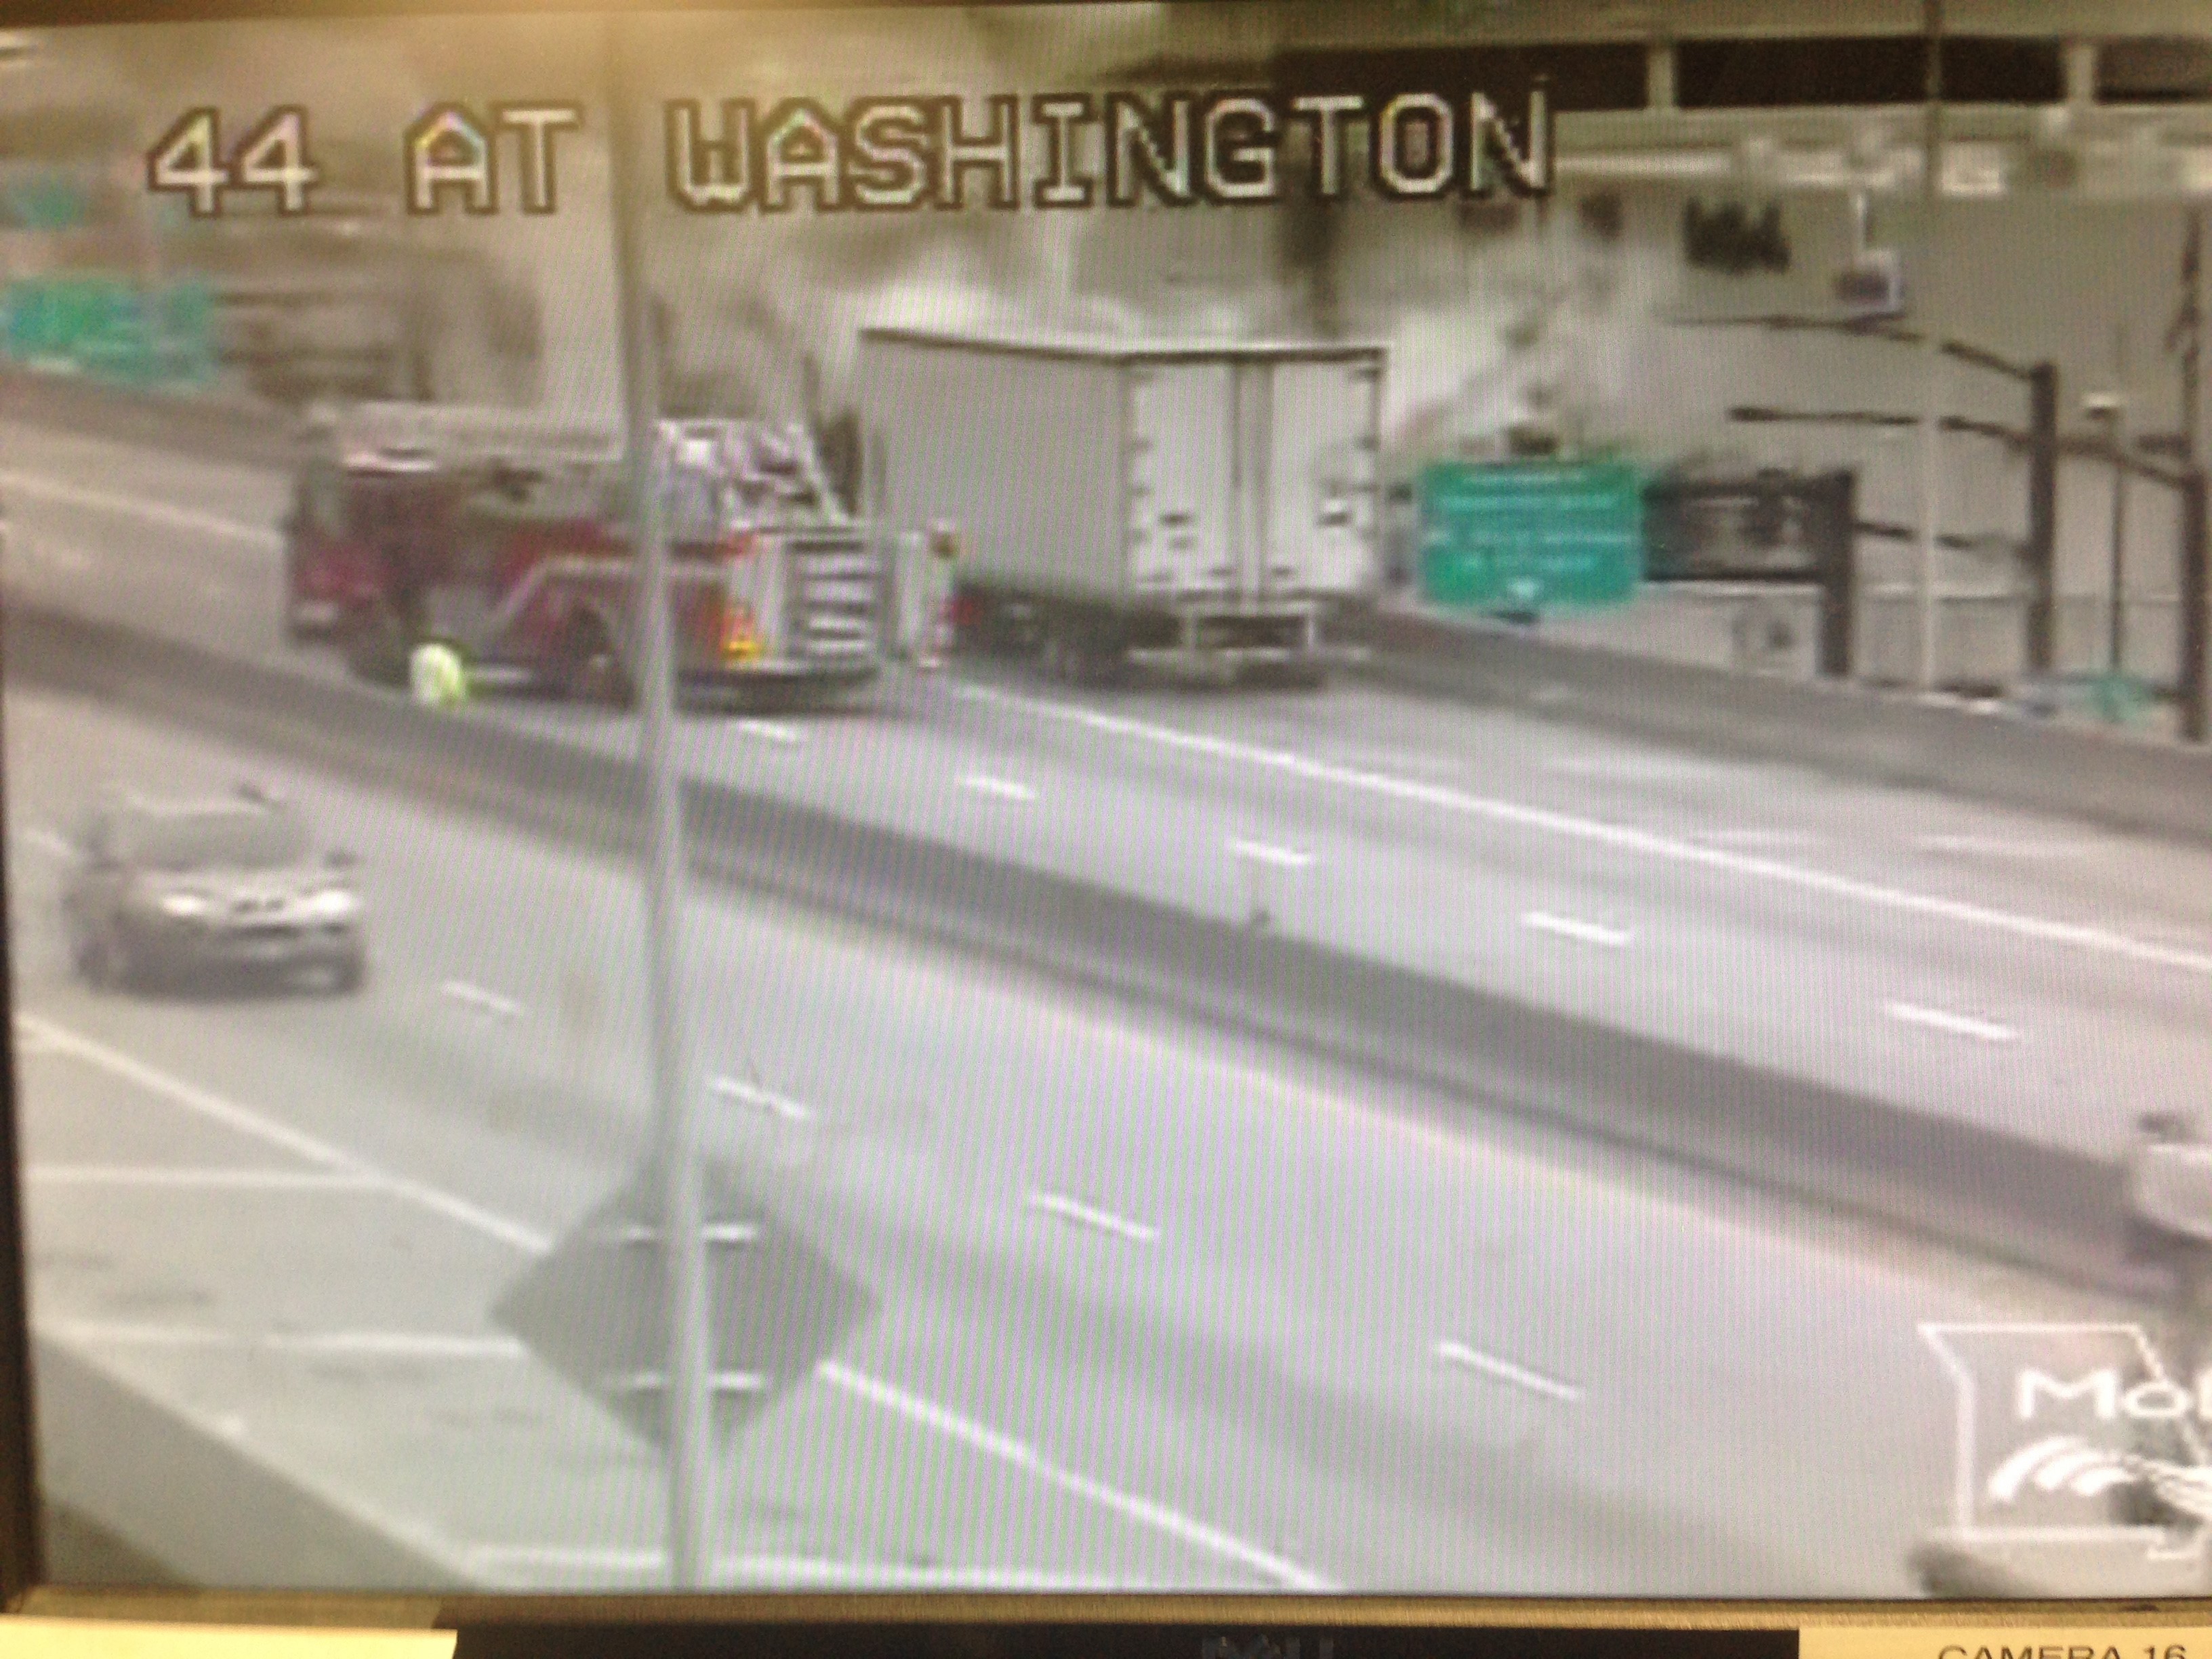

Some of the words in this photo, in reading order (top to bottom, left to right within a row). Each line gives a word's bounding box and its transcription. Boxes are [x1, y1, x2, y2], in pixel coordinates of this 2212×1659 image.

[148, 104, 319, 216] 44
[405, 100, 583, 214] AT
[668, 88, 1552, 213] WASHINGTON
[2015, 1366, 2212, 1420] Mo
